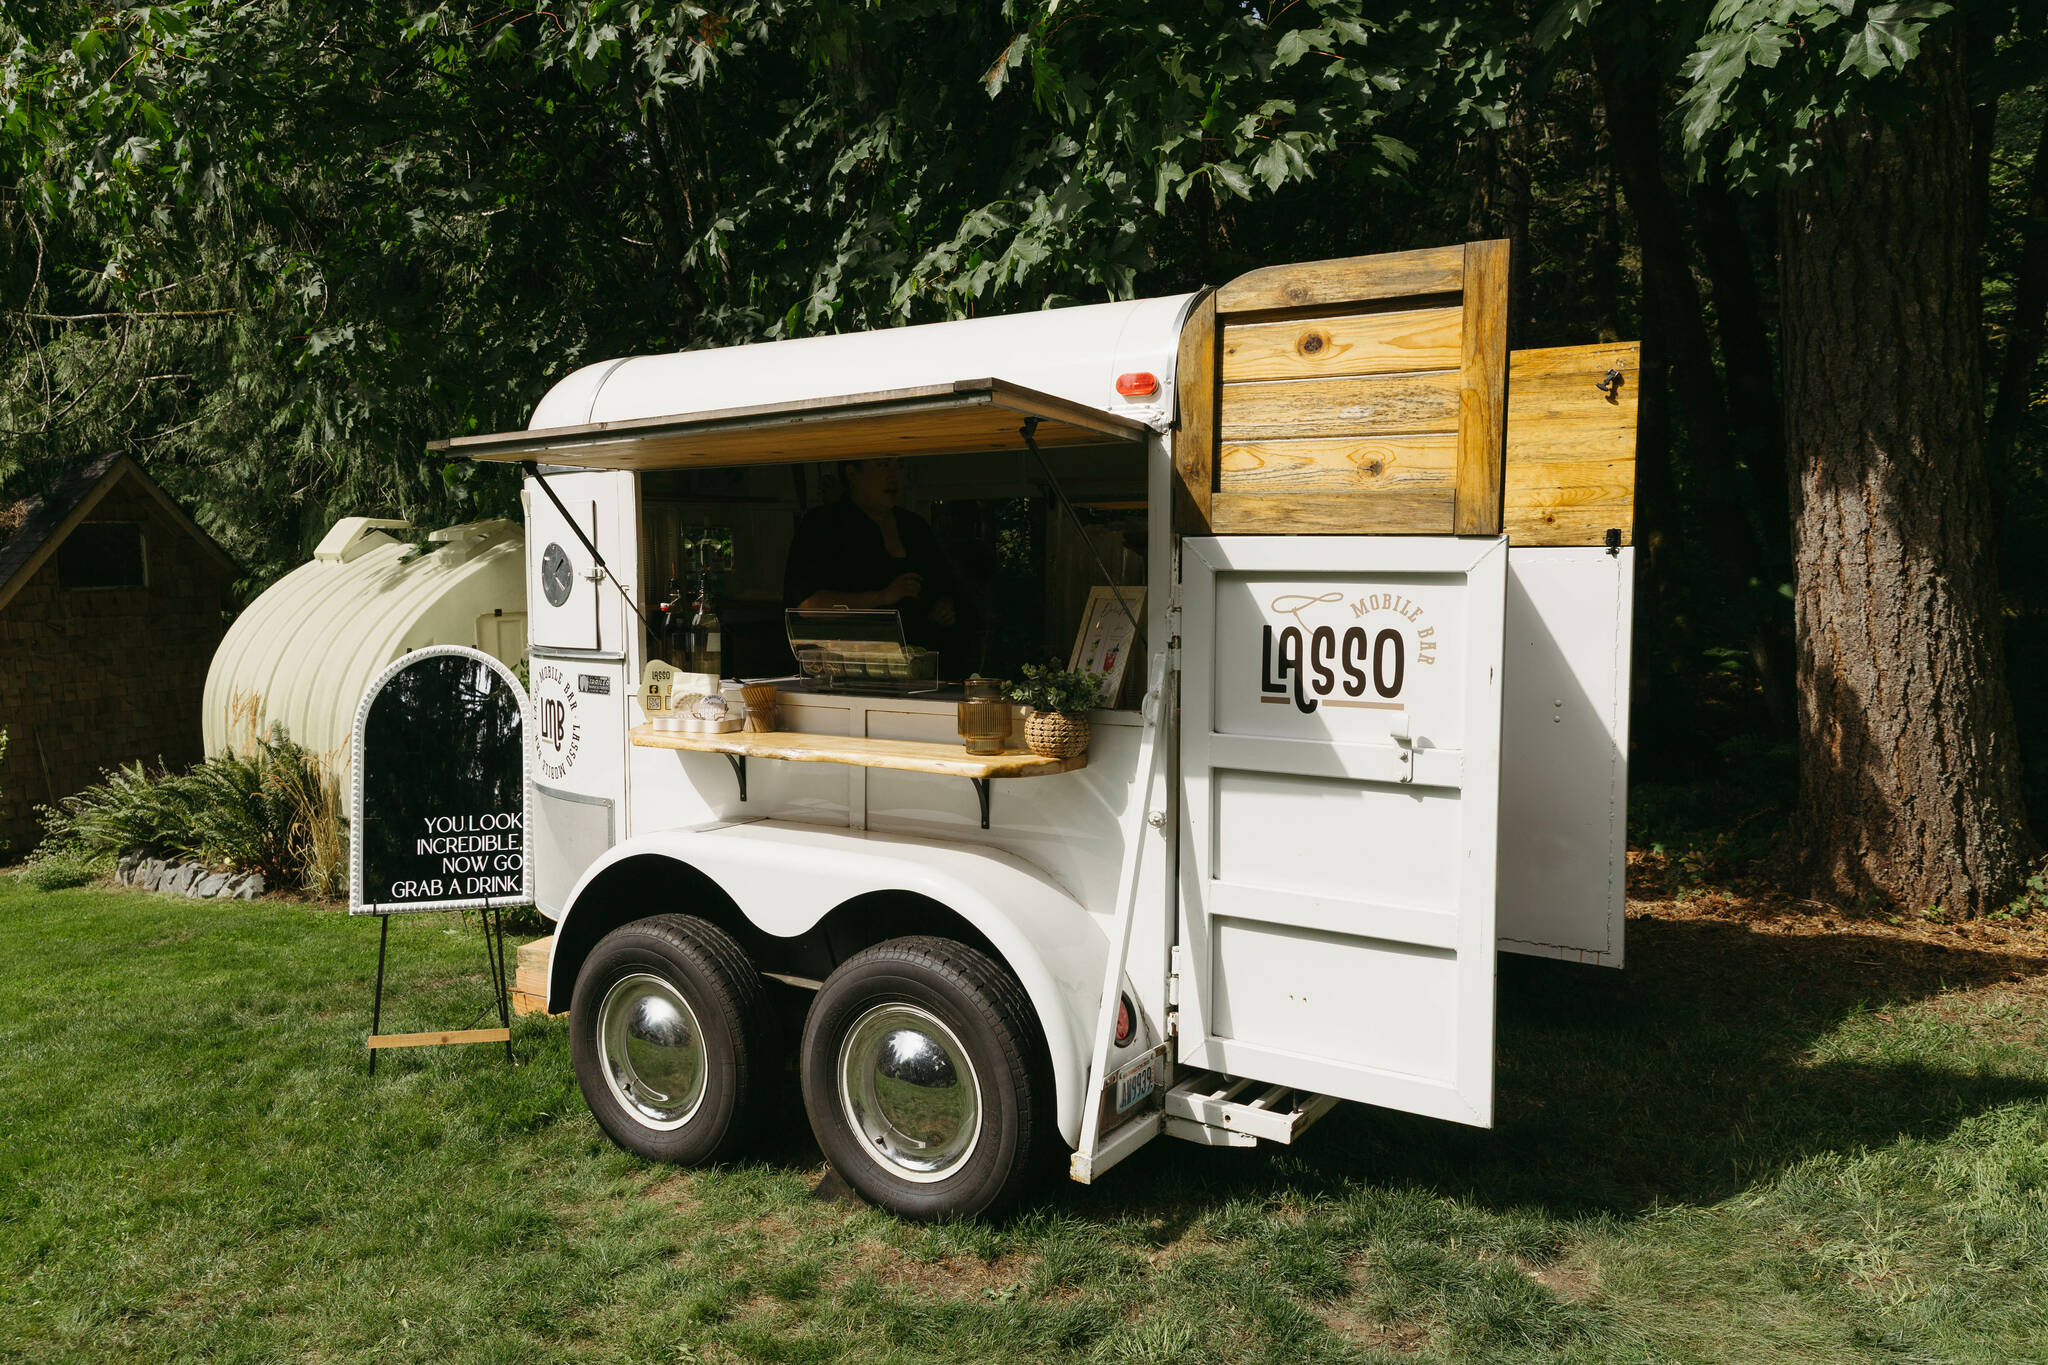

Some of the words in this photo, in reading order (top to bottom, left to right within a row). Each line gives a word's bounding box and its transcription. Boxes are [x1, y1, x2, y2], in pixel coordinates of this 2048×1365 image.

[1350, 593, 1424, 623] MOBILE
[1416, 625, 1438, 666] BAR
[652, 671, 671, 681] LASSO
[1261, 624, 1405, 714] LASSO
[539, 666, 563, 685] MOBILE
[564, 683, 578, 711] BAR
[566, 724, 581, 767] LASSO
[424, 815, 464, 833] YOU
[469, 812, 523, 832] LOOK
[443, 855, 489, 874] NOW
[494, 854, 523, 871] GO
[391, 879, 443, 898] GRAB
[448, 878, 462, 895] A
[467, 874, 523, 894] DRINK.
